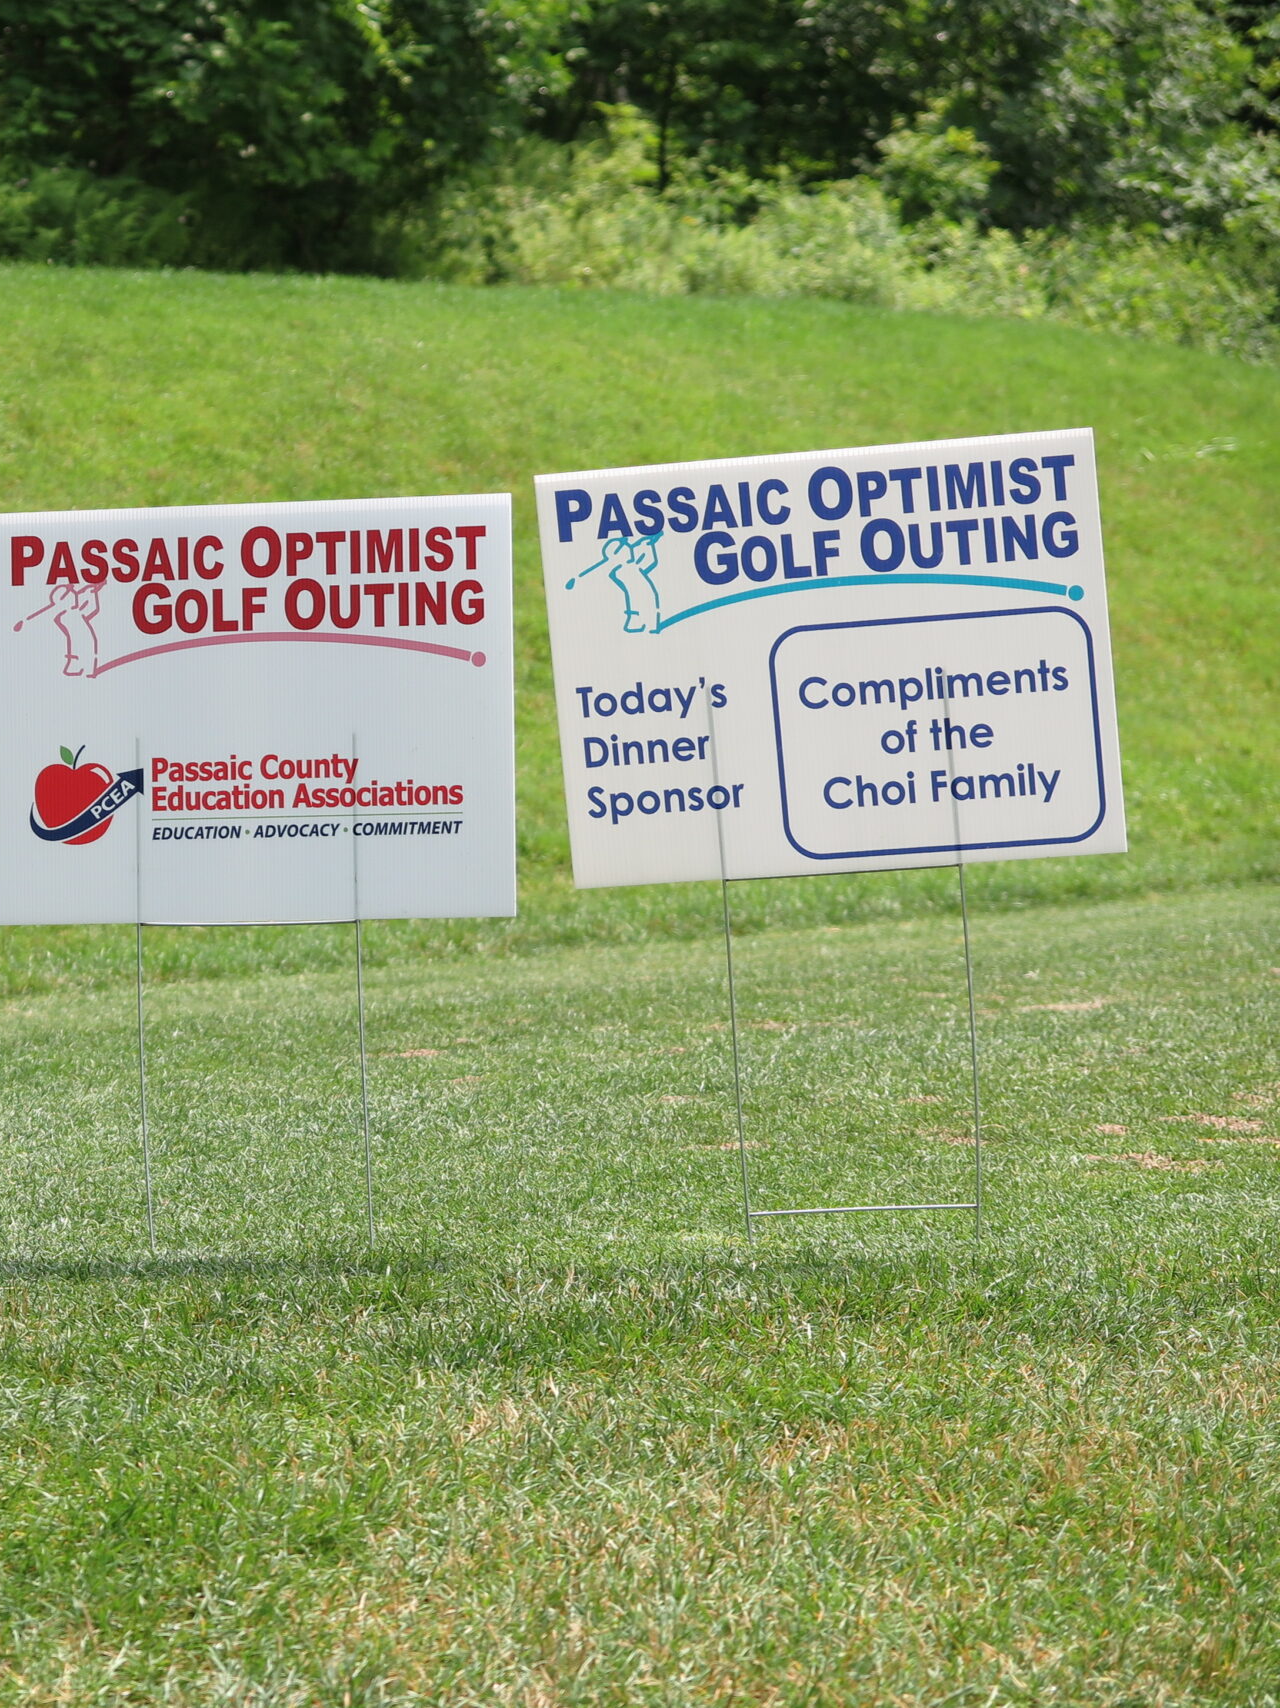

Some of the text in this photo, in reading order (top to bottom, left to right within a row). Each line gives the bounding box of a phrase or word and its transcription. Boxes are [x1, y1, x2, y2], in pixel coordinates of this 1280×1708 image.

[554, 454, 1075, 542] PASSAIC OPTIMIST
[11, 525, 486, 586] PASSAIC OPTIMIST
[693, 512, 1079, 586] GOLF OUTING
[132, 578, 485, 634] GOLF OUTING
[798, 660, 1069, 710] Compliments
[584, 732, 709, 768] Dinner
[880, 718, 994, 755] of the
[151, 754, 359, 784] Passaic County
[823, 763, 1061, 809] Choi Family
[90, 779, 135, 819] PCEA
[151, 779, 463, 812] Education Associations
[587, 783, 744, 824] Sponsor
[152, 821, 463, 841] EDUCATION ADVOCACY COMMITMENT
